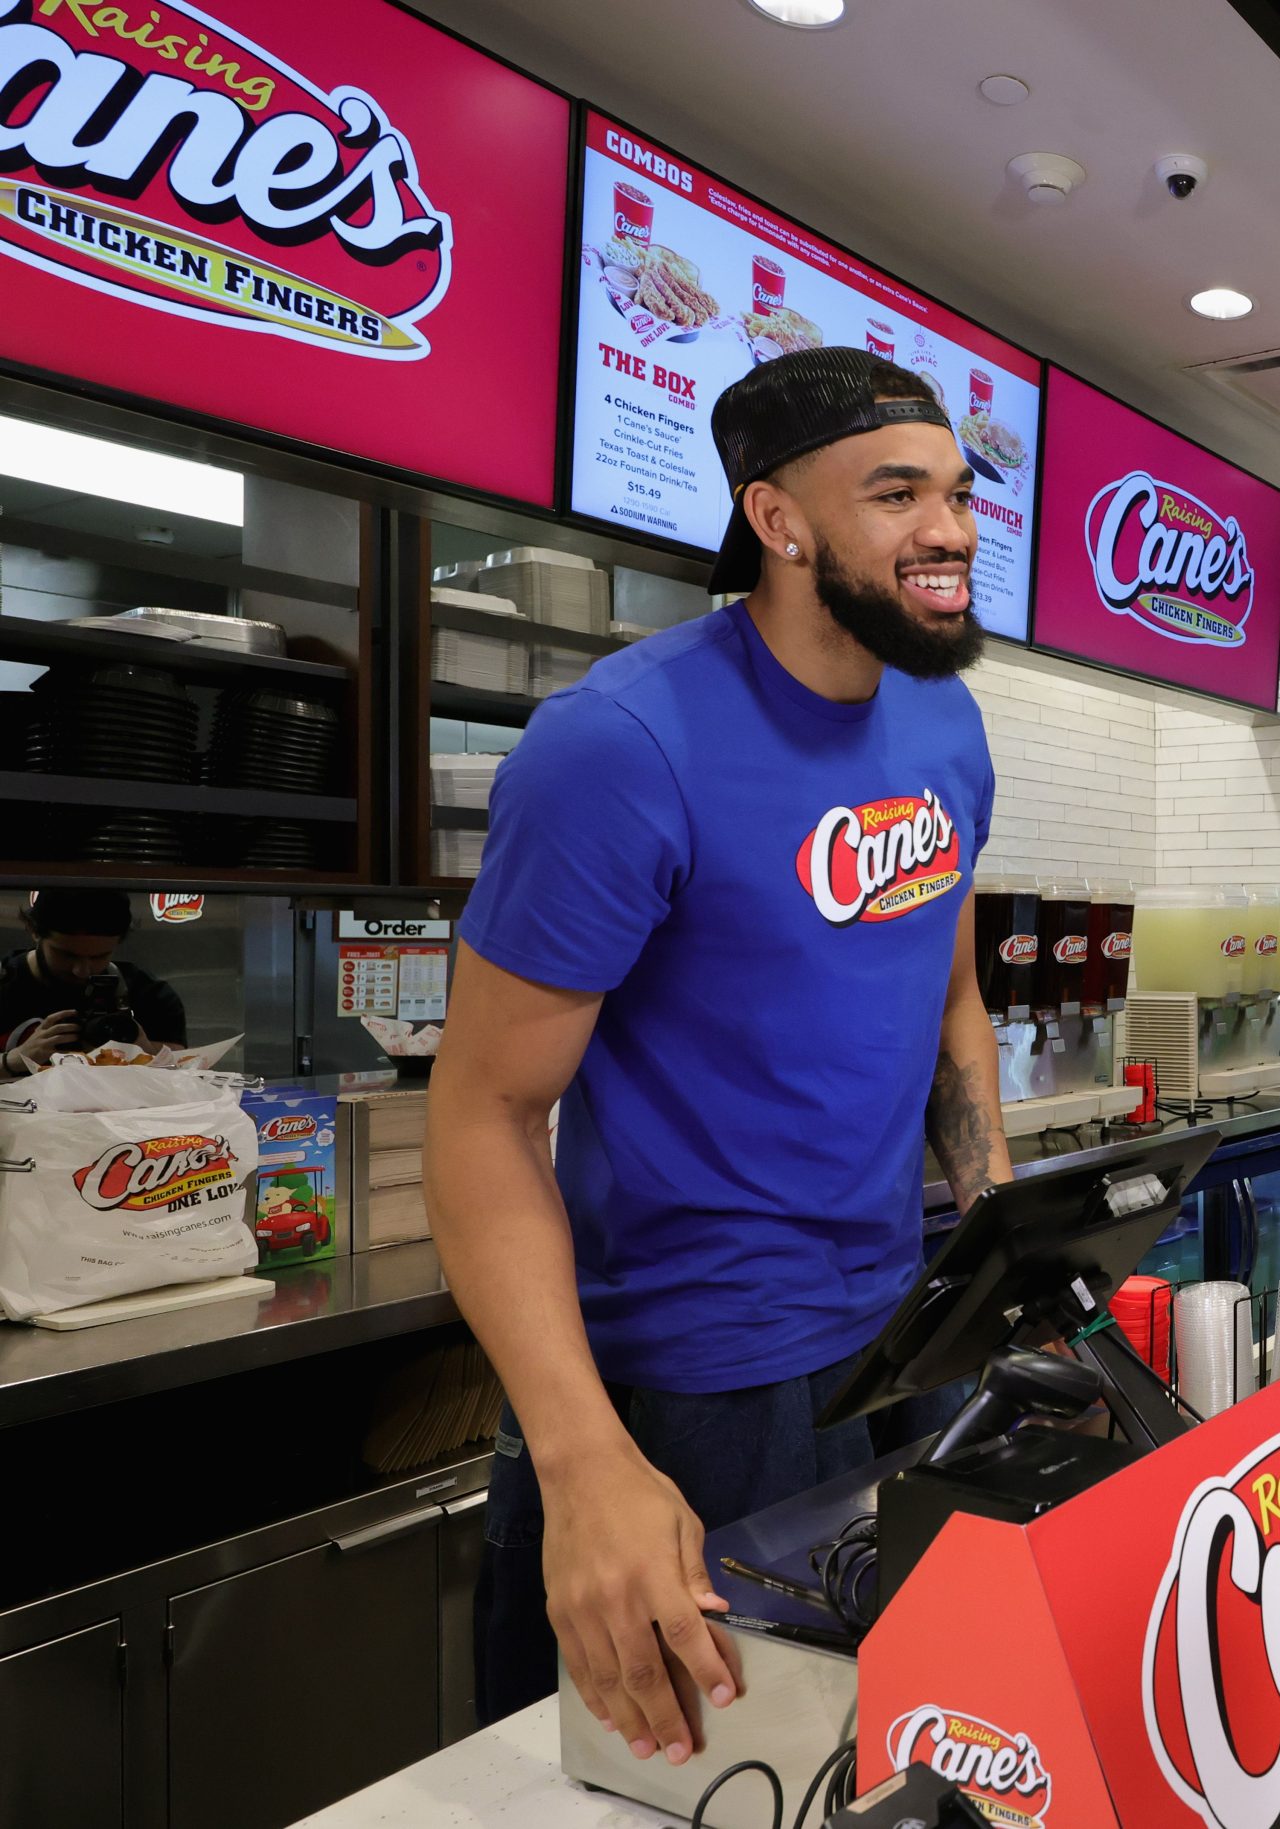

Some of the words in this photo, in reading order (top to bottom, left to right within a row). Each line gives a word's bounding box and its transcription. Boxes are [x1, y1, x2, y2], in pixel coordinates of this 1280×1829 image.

[0, 10, 444, 258] ane's
[606, 129, 693, 193] COMBOS
[614, 211, 650, 239] Cane's
[727, 206, 748, 222] charge
[749, 217, 758, 227] for
[758, 223, 787, 243] lemonade
[787, 239, 799, 250] with
[800, 246, 810, 257] any
[738, 204, 752, 216] fries
[753, 213, 764, 223] and
[764, 218, 779, 232] toast
[780, 227, 790, 237] can
[791, 233, 798, 241] be
[799, 239, 829, 258] substituted
[838, 260, 849, 269] one
[16, 187, 209, 288] CHICKEN
[224, 260, 380, 342] FINGERS
[640, 333, 656, 348] ONE
[654, 322, 671, 338] LOVE
[598, 342, 646, 381] THE
[652, 364, 696, 400] BOX
[910, 355, 938, 367] CANIAC
[604, 394, 612, 404] 4
[614, 398, 656, 421] Chicken
[658, 413, 695, 435] Fingers
[668, 394, 696, 411] COMBO
[618, 415, 622, 423] 1
[623, 417, 653, 434] Cane's
[600, 438, 624, 454] Texas
[626, 447, 649, 462] Toast
[650, 456, 657, 464] &
[659, 459, 696, 478] Coleslaw
[613, 428, 662, 452] Crinkle-Cut
[663, 444, 684, 460] Fries
[595, 452, 618, 467] 22oz
[620, 460, 657, 480] Fountain
[659, 473, 698, 493] Drink/Tea
[627, 481, 662, 500] $15.49
[619, 507, 646, 522] SODIUM
[647, 515, 678, 531] WARNING
[968, 496, 1024, 529] NDWICH
[1160, 494, 1213, 540] Raising
[991, 538, 1013, 552] Fingers
[1096, 474, 1251, 602] Cane's
[1151, 596, 1193, 625] CHICKEN
[1195, 612, 1234, 639] FINGERS
[861, 801, 915, 830] Raising
[810, 787, 953, 925] Cane's
[879, 888, 915, 911] CHICKEN
[919, 873, 955, 896] FINGERS
[364, 919, 427, 936] Order
[264, 1114, 315, 1141] Cane's
[145, 1135, 204, 1155] Raising
[143, 1184, 183, 1205] CHICKEN
[187, 1169, 232, 1189] FINGERS
[167, 1193, 202, 1213] ONE
[207, 1182, 246, 1200] LOV
[80, 1256, 96, 1265] THIS
[97, 1258, 113, 1266] BAG
[896, 1706, 1047, 1794] Cane's
[948, 1718, 1001, 1751] Raising
[988, 1803, 1030, 1826] FINGERS
